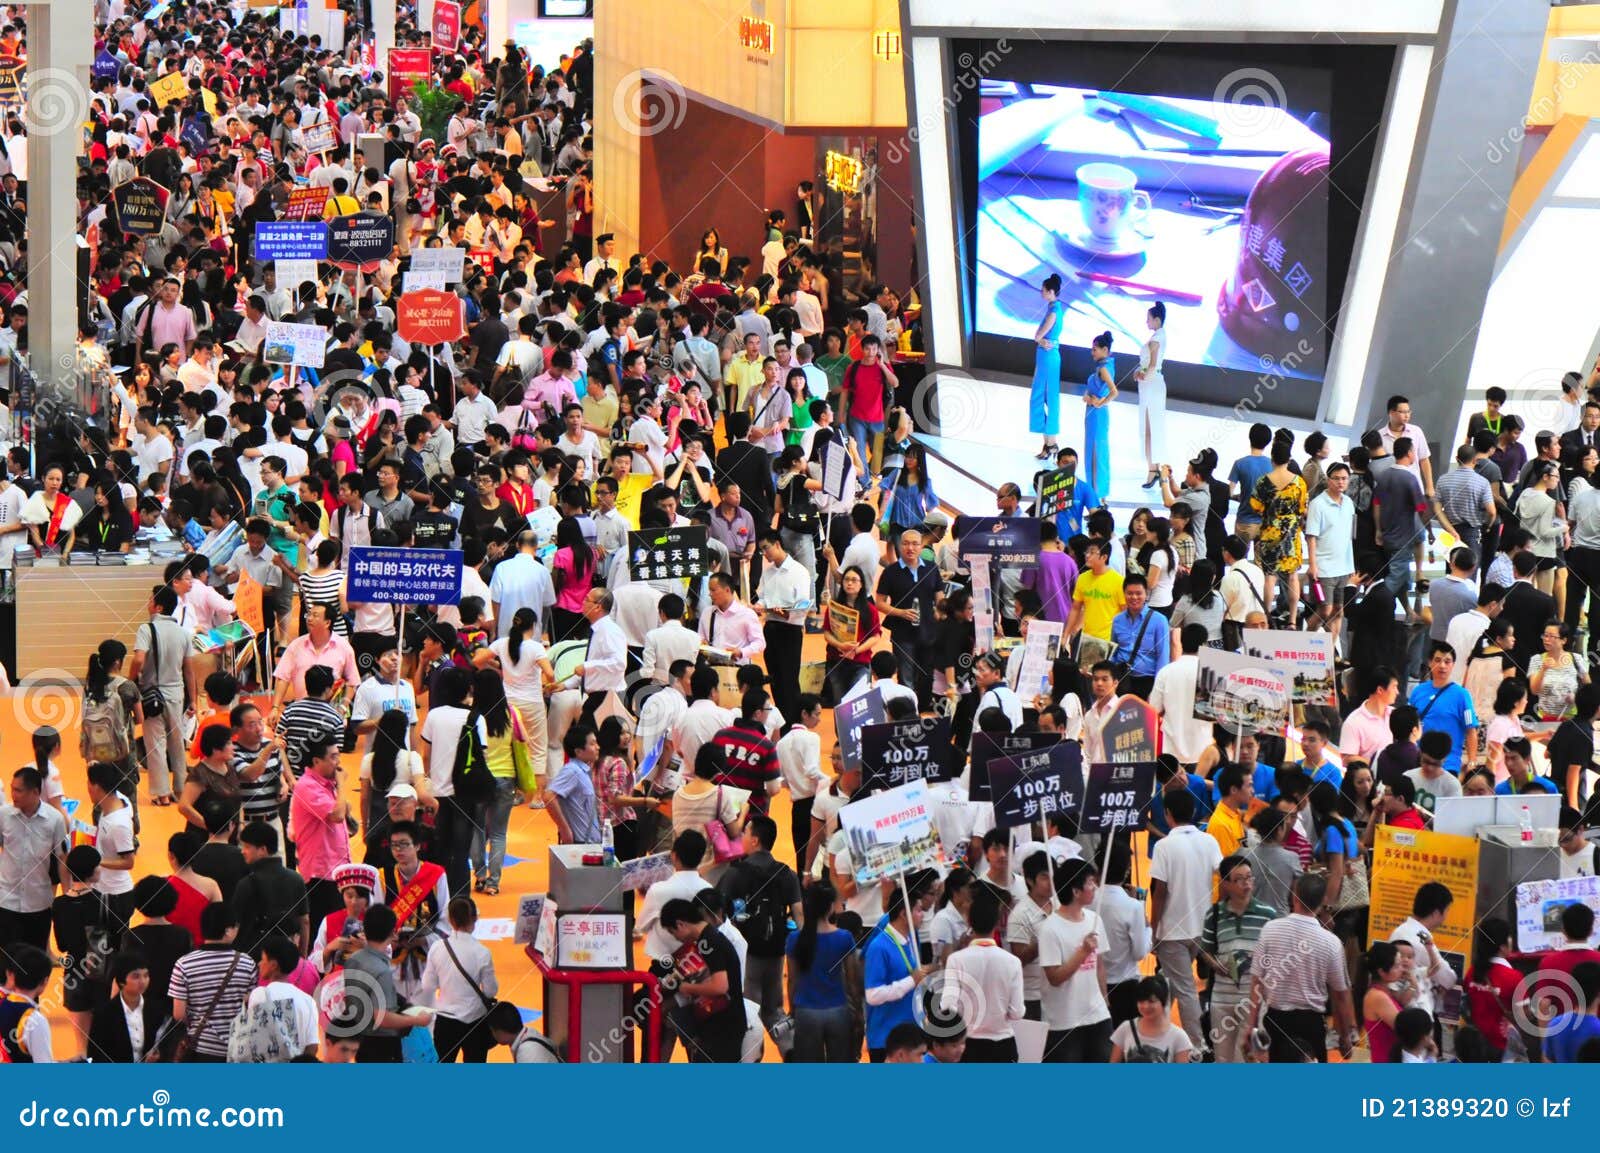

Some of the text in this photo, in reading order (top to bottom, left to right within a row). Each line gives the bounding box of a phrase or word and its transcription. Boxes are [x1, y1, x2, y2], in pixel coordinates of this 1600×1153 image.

[355, 561, 456, 577] 中国的马尔代夫
[354, 579, 455, 590] 看楼车会展中心站免费接送
[372, 591, 435, 600] 400-880-0009
[883, 746, 929, 763] 100万
[873, 763, 940, 782] 一步到位
[1013, 775, 1061, 798] 100万
[1006, 791, 1076, 817] 一步到位
[1100, 791, 1136, 806] 100万
[1089, 810, 1140, 827] 一步到位
[562, 921, 620, 936] 兰亭国际
